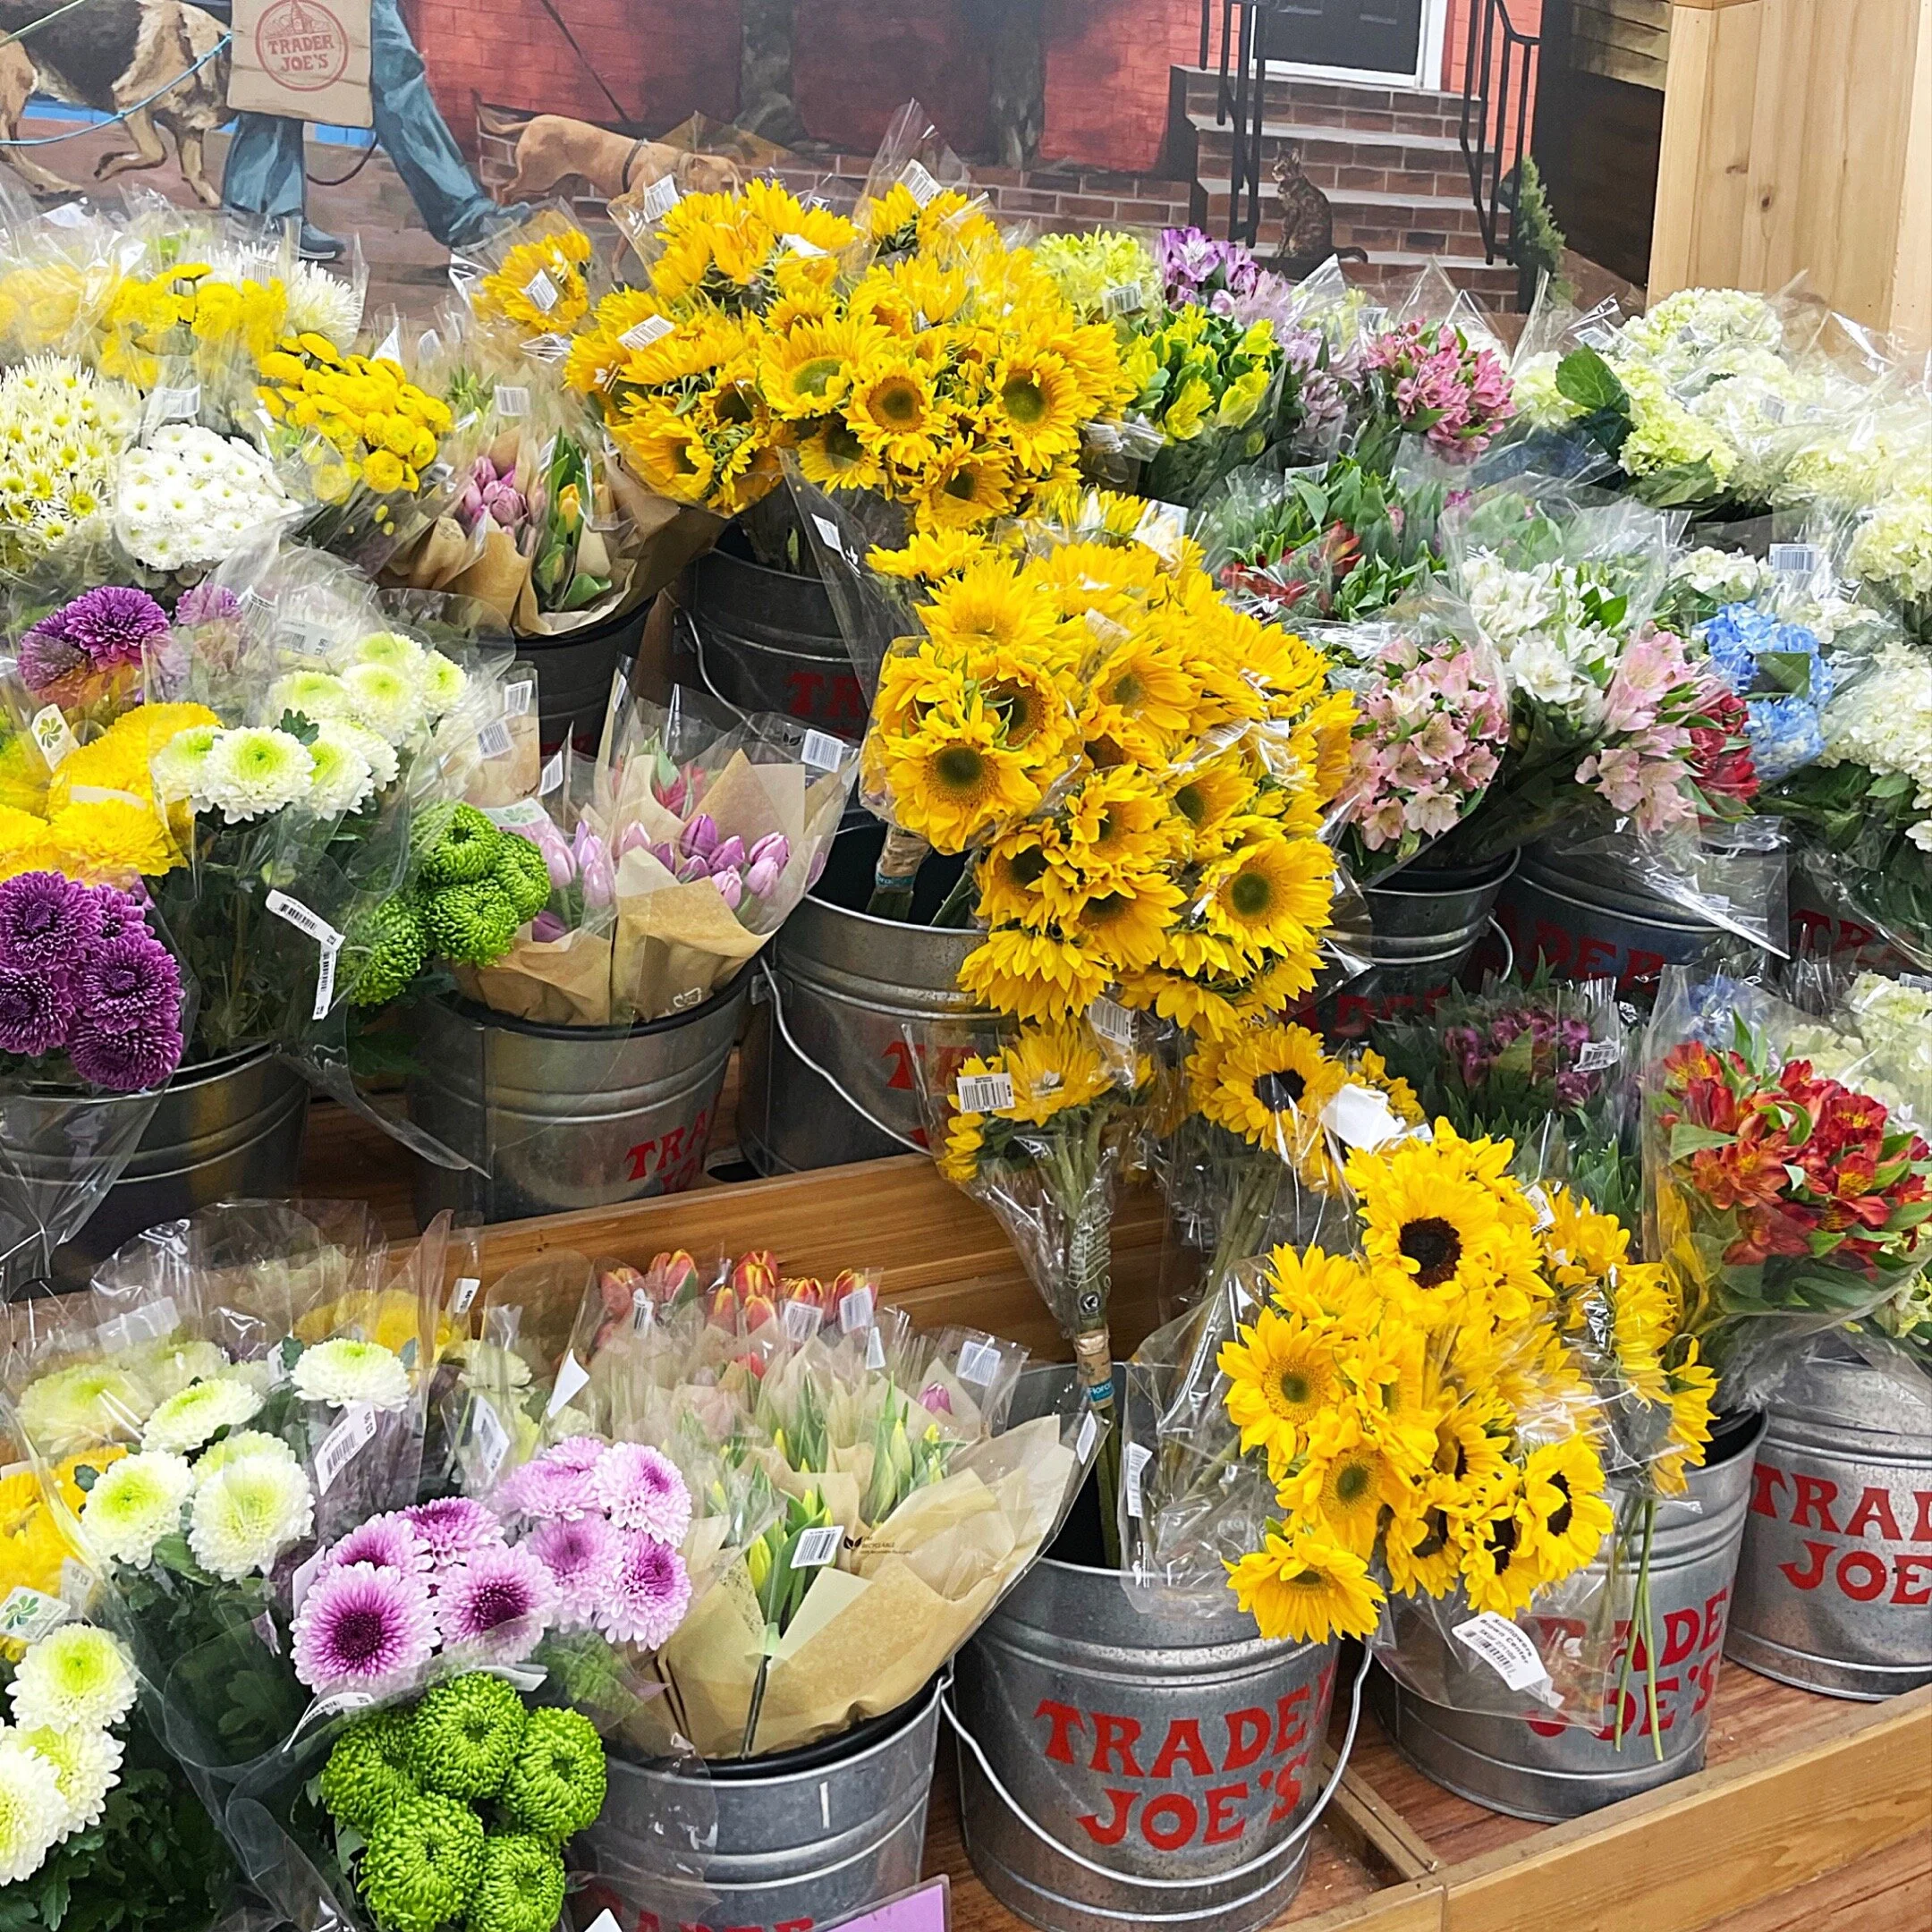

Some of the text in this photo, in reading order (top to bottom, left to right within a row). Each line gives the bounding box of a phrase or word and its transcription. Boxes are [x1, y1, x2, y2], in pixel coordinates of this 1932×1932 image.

[267, 34, 335, 55] TRADER
[280, 53, 329, 72] JOE'S
[1479, 1618, 1530, 1665] Brown Center
[1492, 1618, 1533, 1657] Sunflowers
[1076, 1751, 1309, 1852] JOE'S
